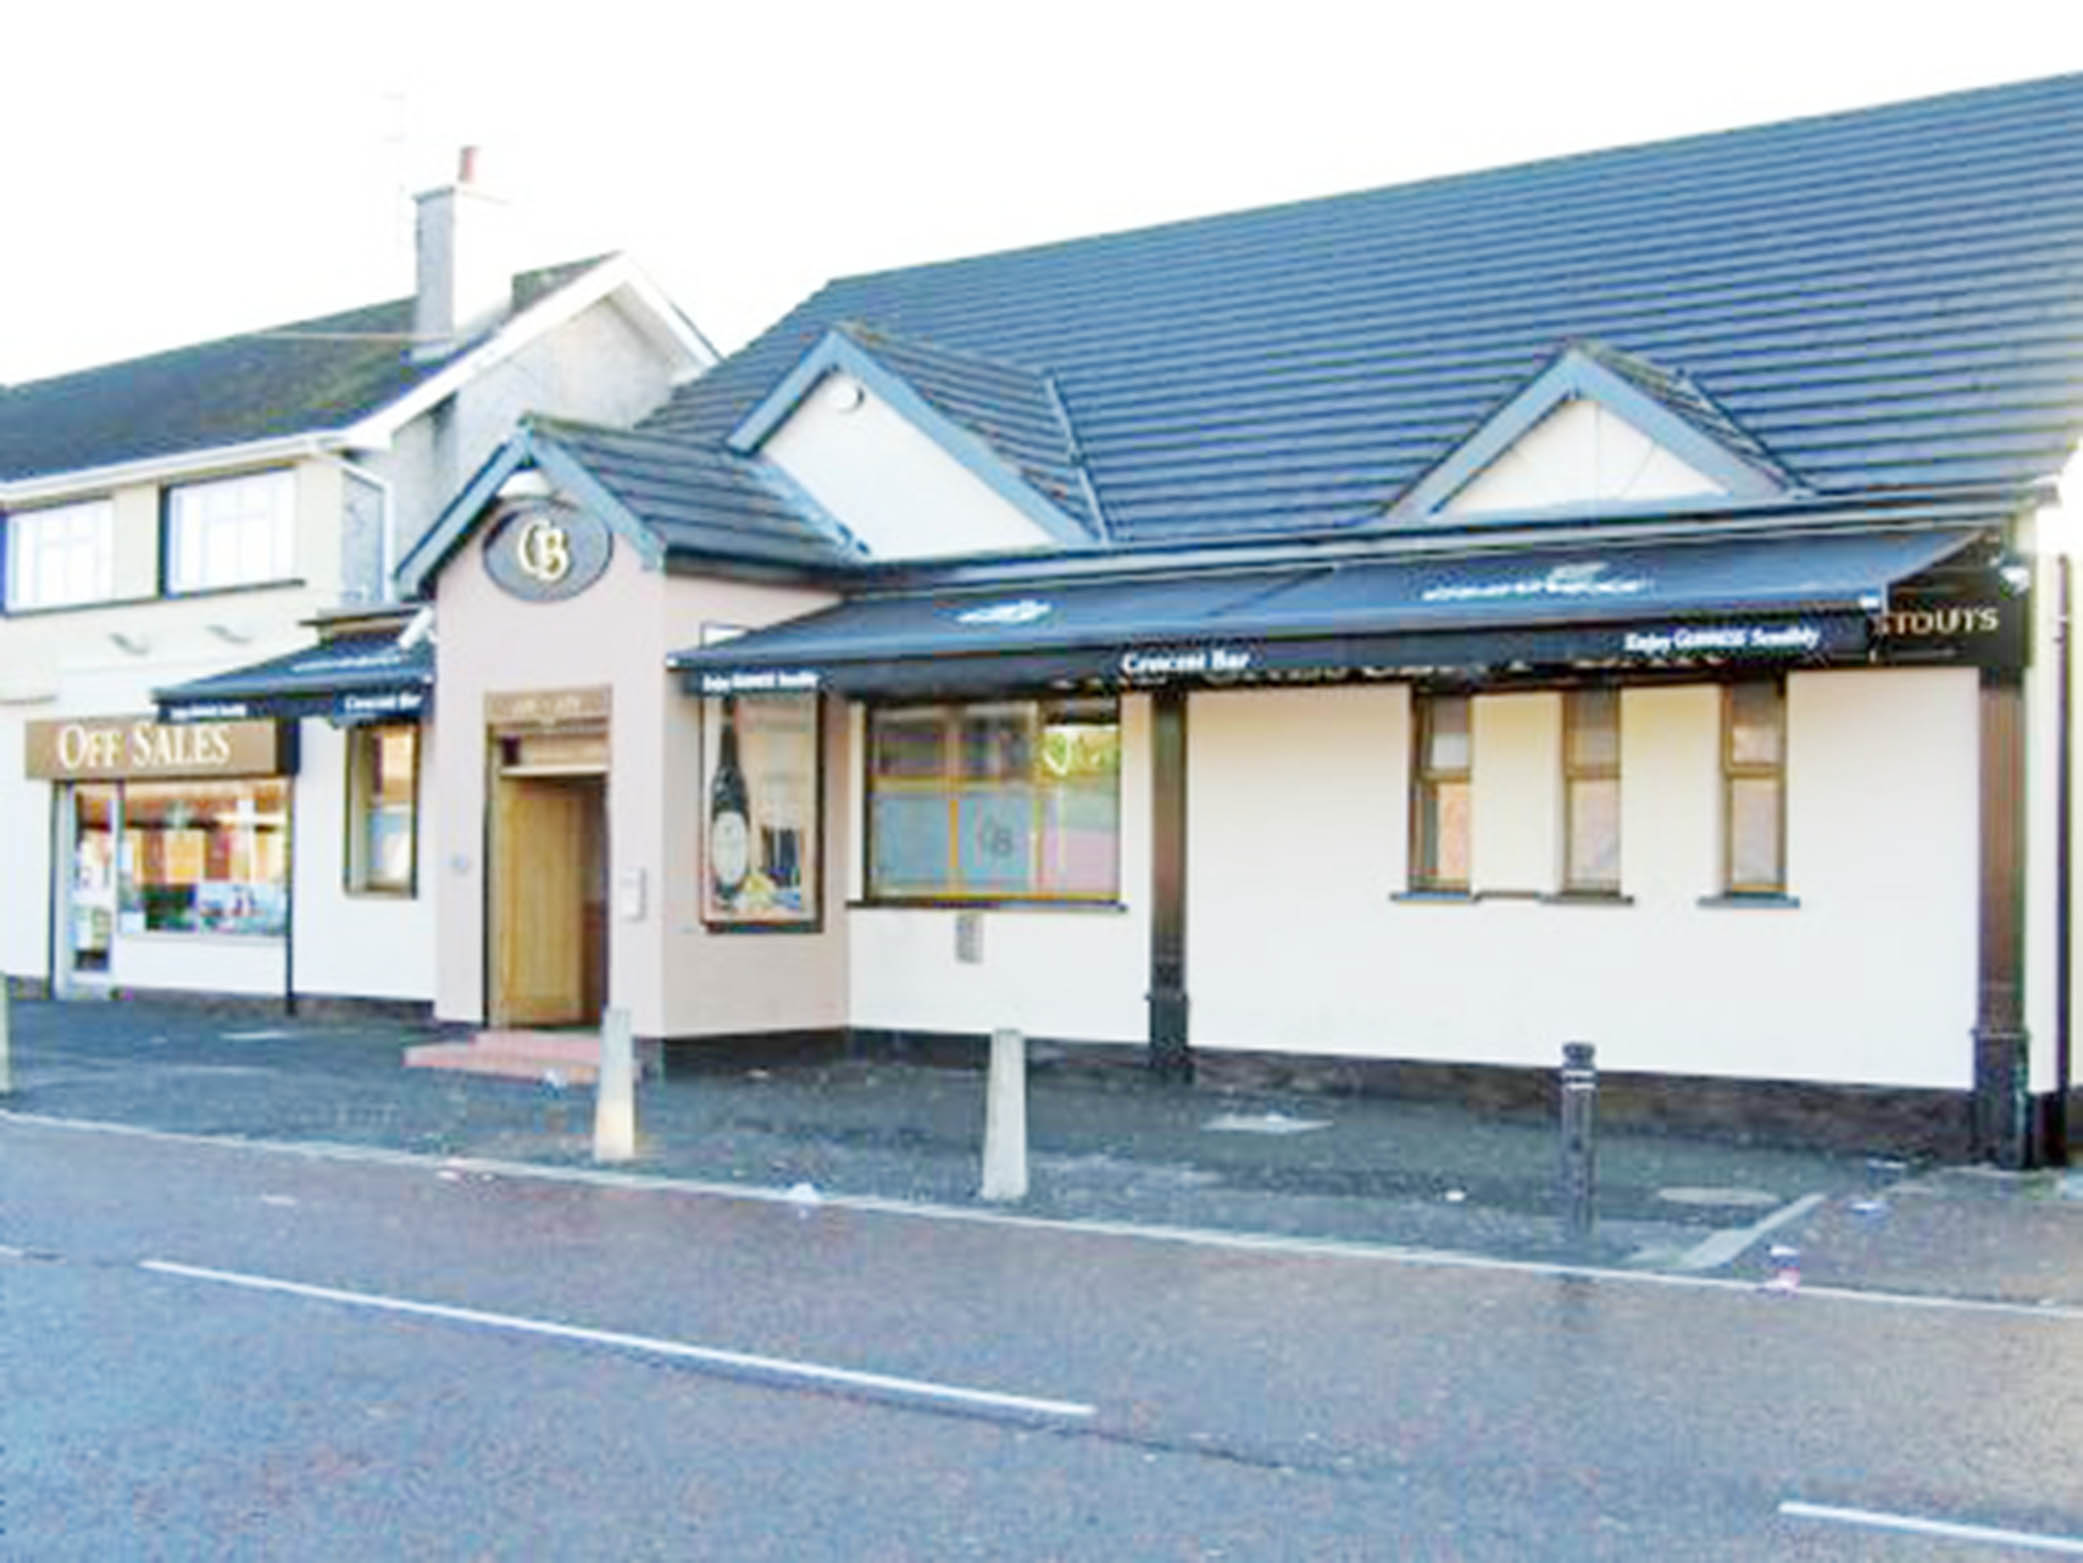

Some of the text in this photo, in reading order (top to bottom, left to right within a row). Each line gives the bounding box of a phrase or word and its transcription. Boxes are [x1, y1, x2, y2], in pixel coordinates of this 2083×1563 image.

[1212, 648, 1250, 670] Bar
[57, 722, 231, 770] OFF SALES
